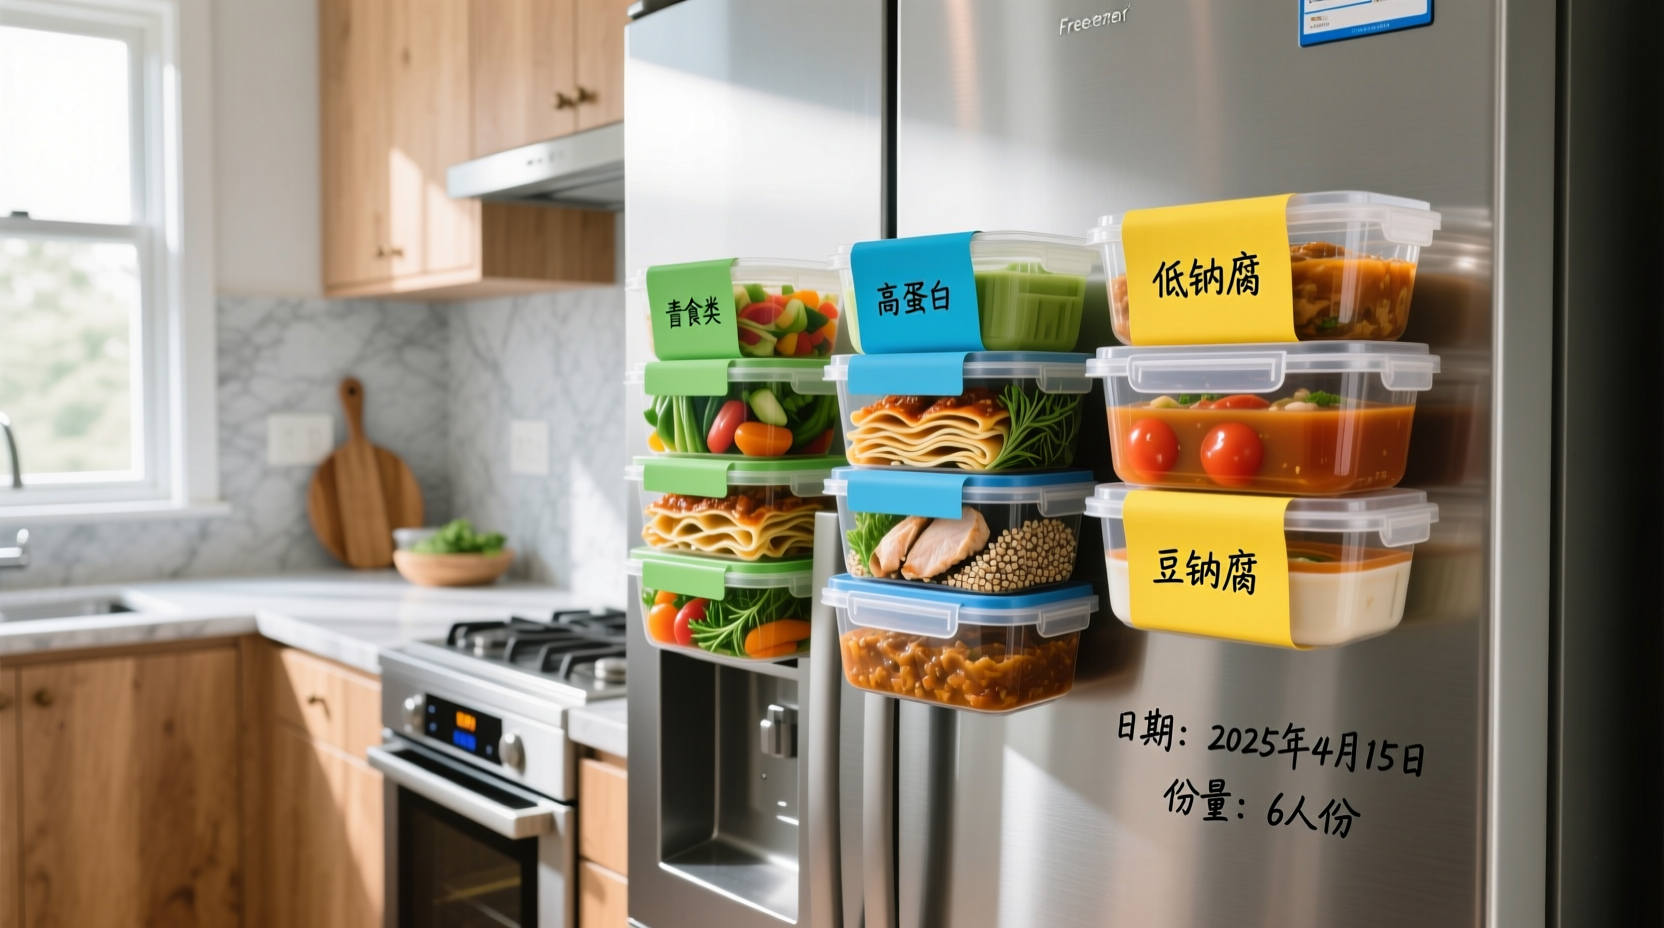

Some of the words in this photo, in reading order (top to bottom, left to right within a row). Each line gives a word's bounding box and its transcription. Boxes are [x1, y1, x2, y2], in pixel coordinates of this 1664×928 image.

[877, 279, 950, 317] 高蛋白
[1152, 250, 1260, 299] 低钠腐
[1152, 548, 1258, 596] 豆钠腐
